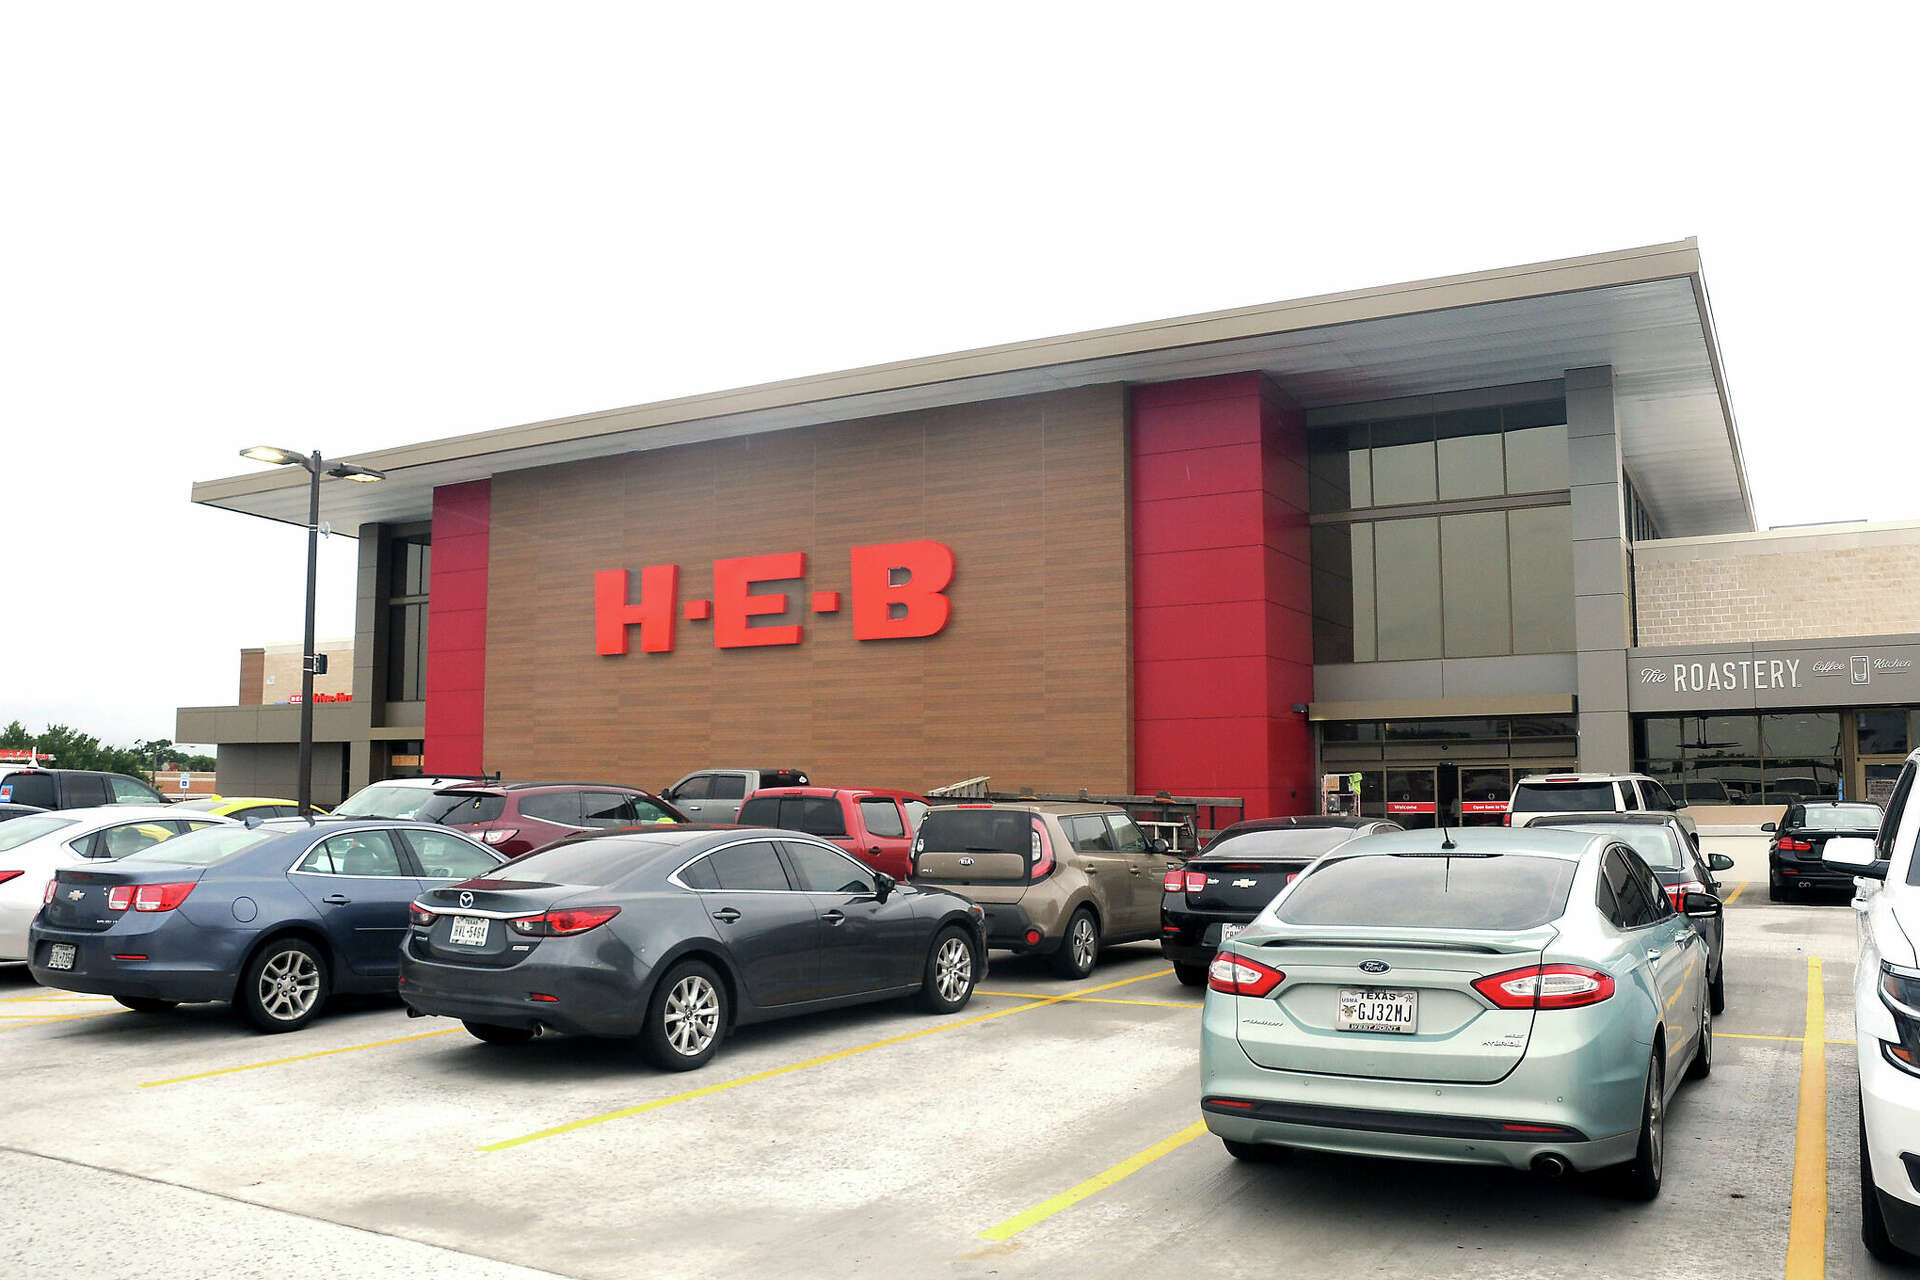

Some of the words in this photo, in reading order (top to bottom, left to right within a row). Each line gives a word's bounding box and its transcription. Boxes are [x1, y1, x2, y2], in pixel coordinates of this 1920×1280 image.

[1640, 667, 1668, 684] The
[1673, 658, 1800, 692] ROASTERY
[1812, 660, 1846, 673] Coffee
[1873, 657, 1912, 669] Kitchen
[1364, 961, 1384, 971] Ford
[1360, 992, 1396, 1001] TEXAS
